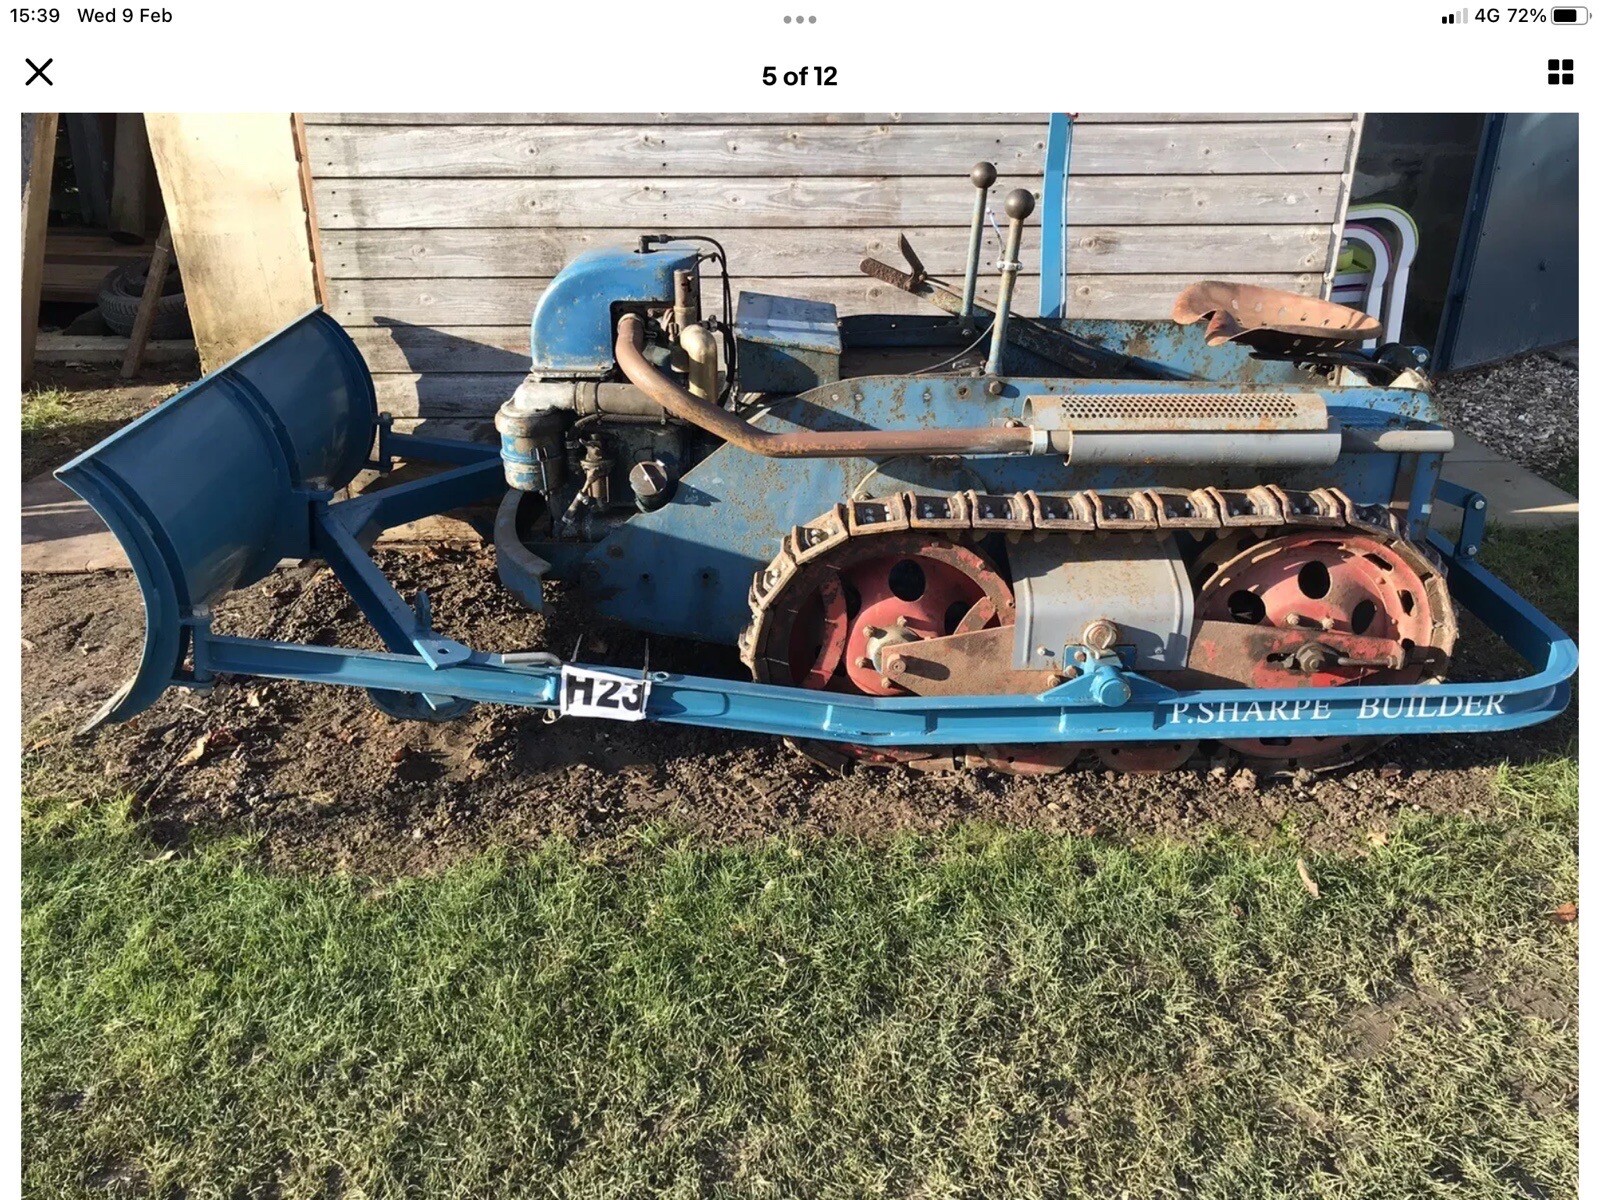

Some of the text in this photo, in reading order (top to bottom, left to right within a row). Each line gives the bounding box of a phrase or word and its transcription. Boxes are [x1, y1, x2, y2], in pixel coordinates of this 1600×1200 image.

[566, 673, 643, 711] H23
[1170, 694, 1505, 724] P.SHARPE BUILDER
